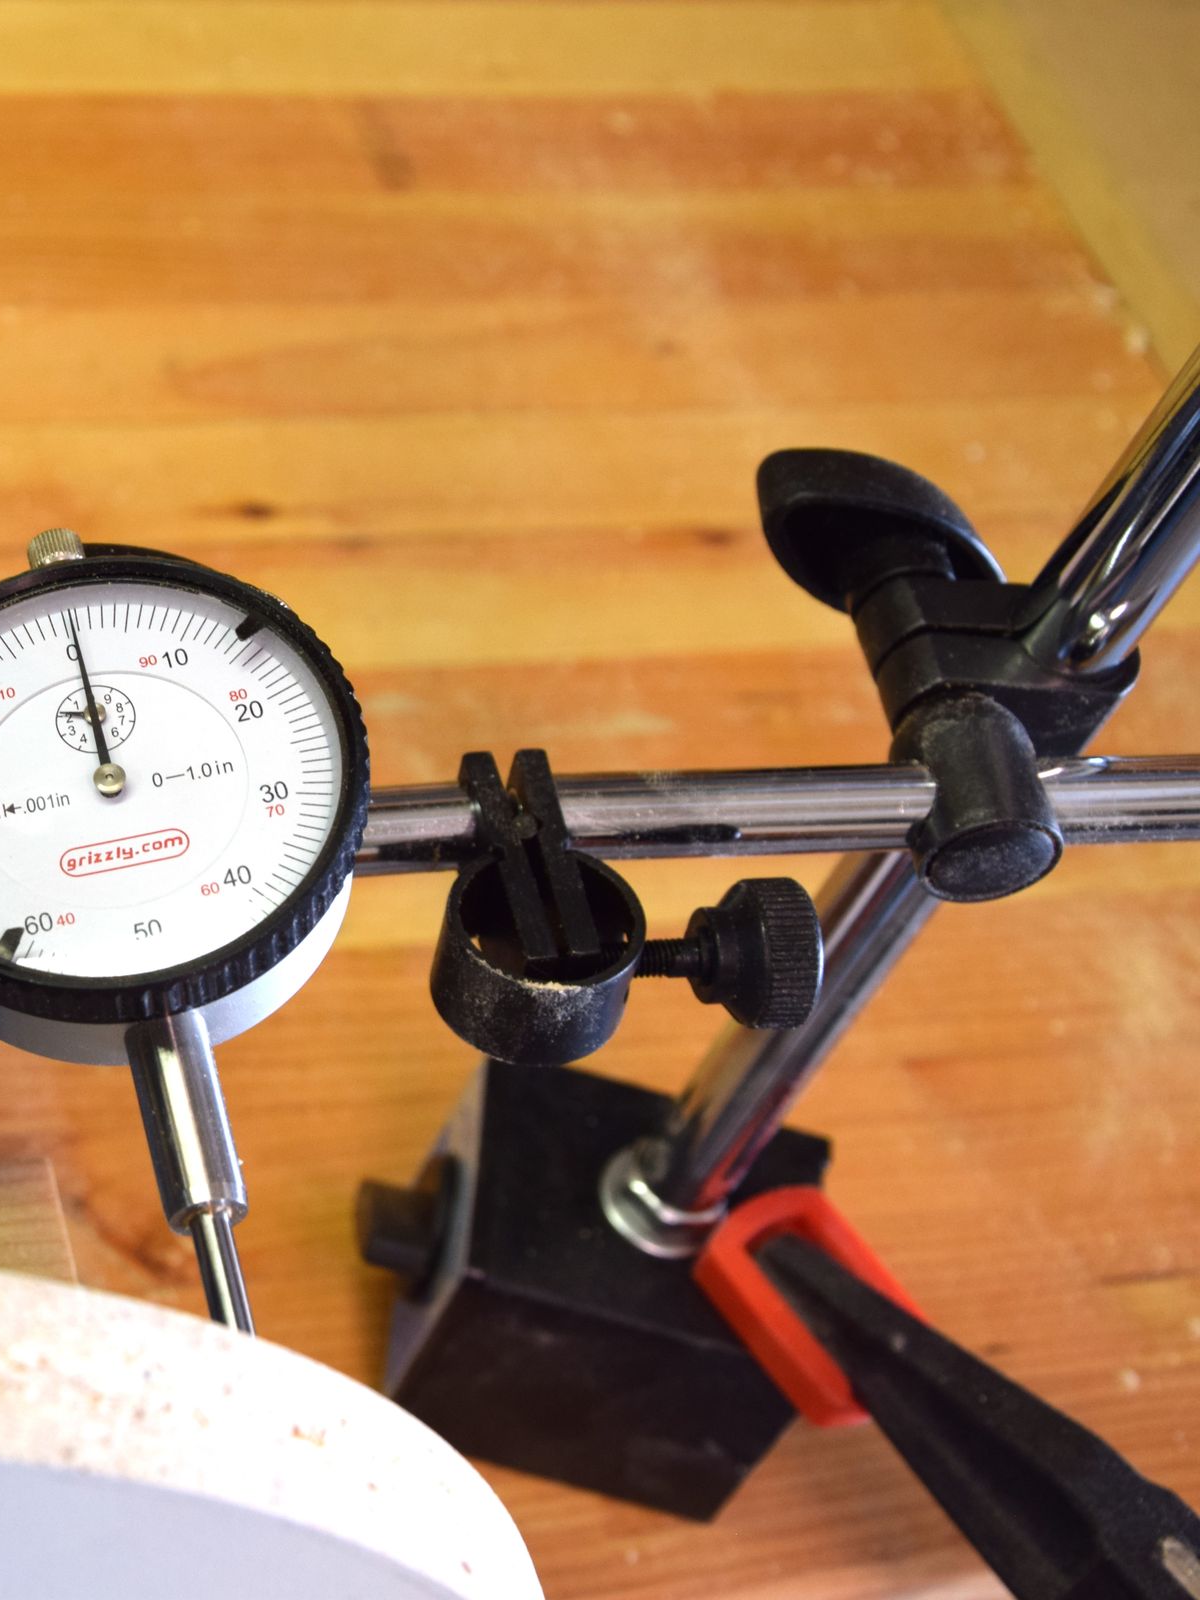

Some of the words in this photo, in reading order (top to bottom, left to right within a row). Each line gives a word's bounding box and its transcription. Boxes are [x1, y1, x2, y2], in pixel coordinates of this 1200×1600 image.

[139, 654, 157, 668] 90
[162, 648, 188, 669] 10
[103, 693, 112, 704] 9
[229, 688, 248, 702] 80
[73, 701, 80, 710] 1
[116, 702, 124, 713] 8
[235, 700, 264, 722] 20
[118, 715, 126, 726] 7
[68, 725, 76, 736] 3
[111, 727, 119, 738] 6
[79, 734, 88, 744] 4
[260, 781, 288, 803] 30
[266, 804, 285, 818] 70
[66, 835, 184, 871] grizzly.com
[223, 865, 252, 887] 40
[201, 882, 220, 896] 60
[24, 912, 53, 935] 60
[56, 912, 75, 926] 40
